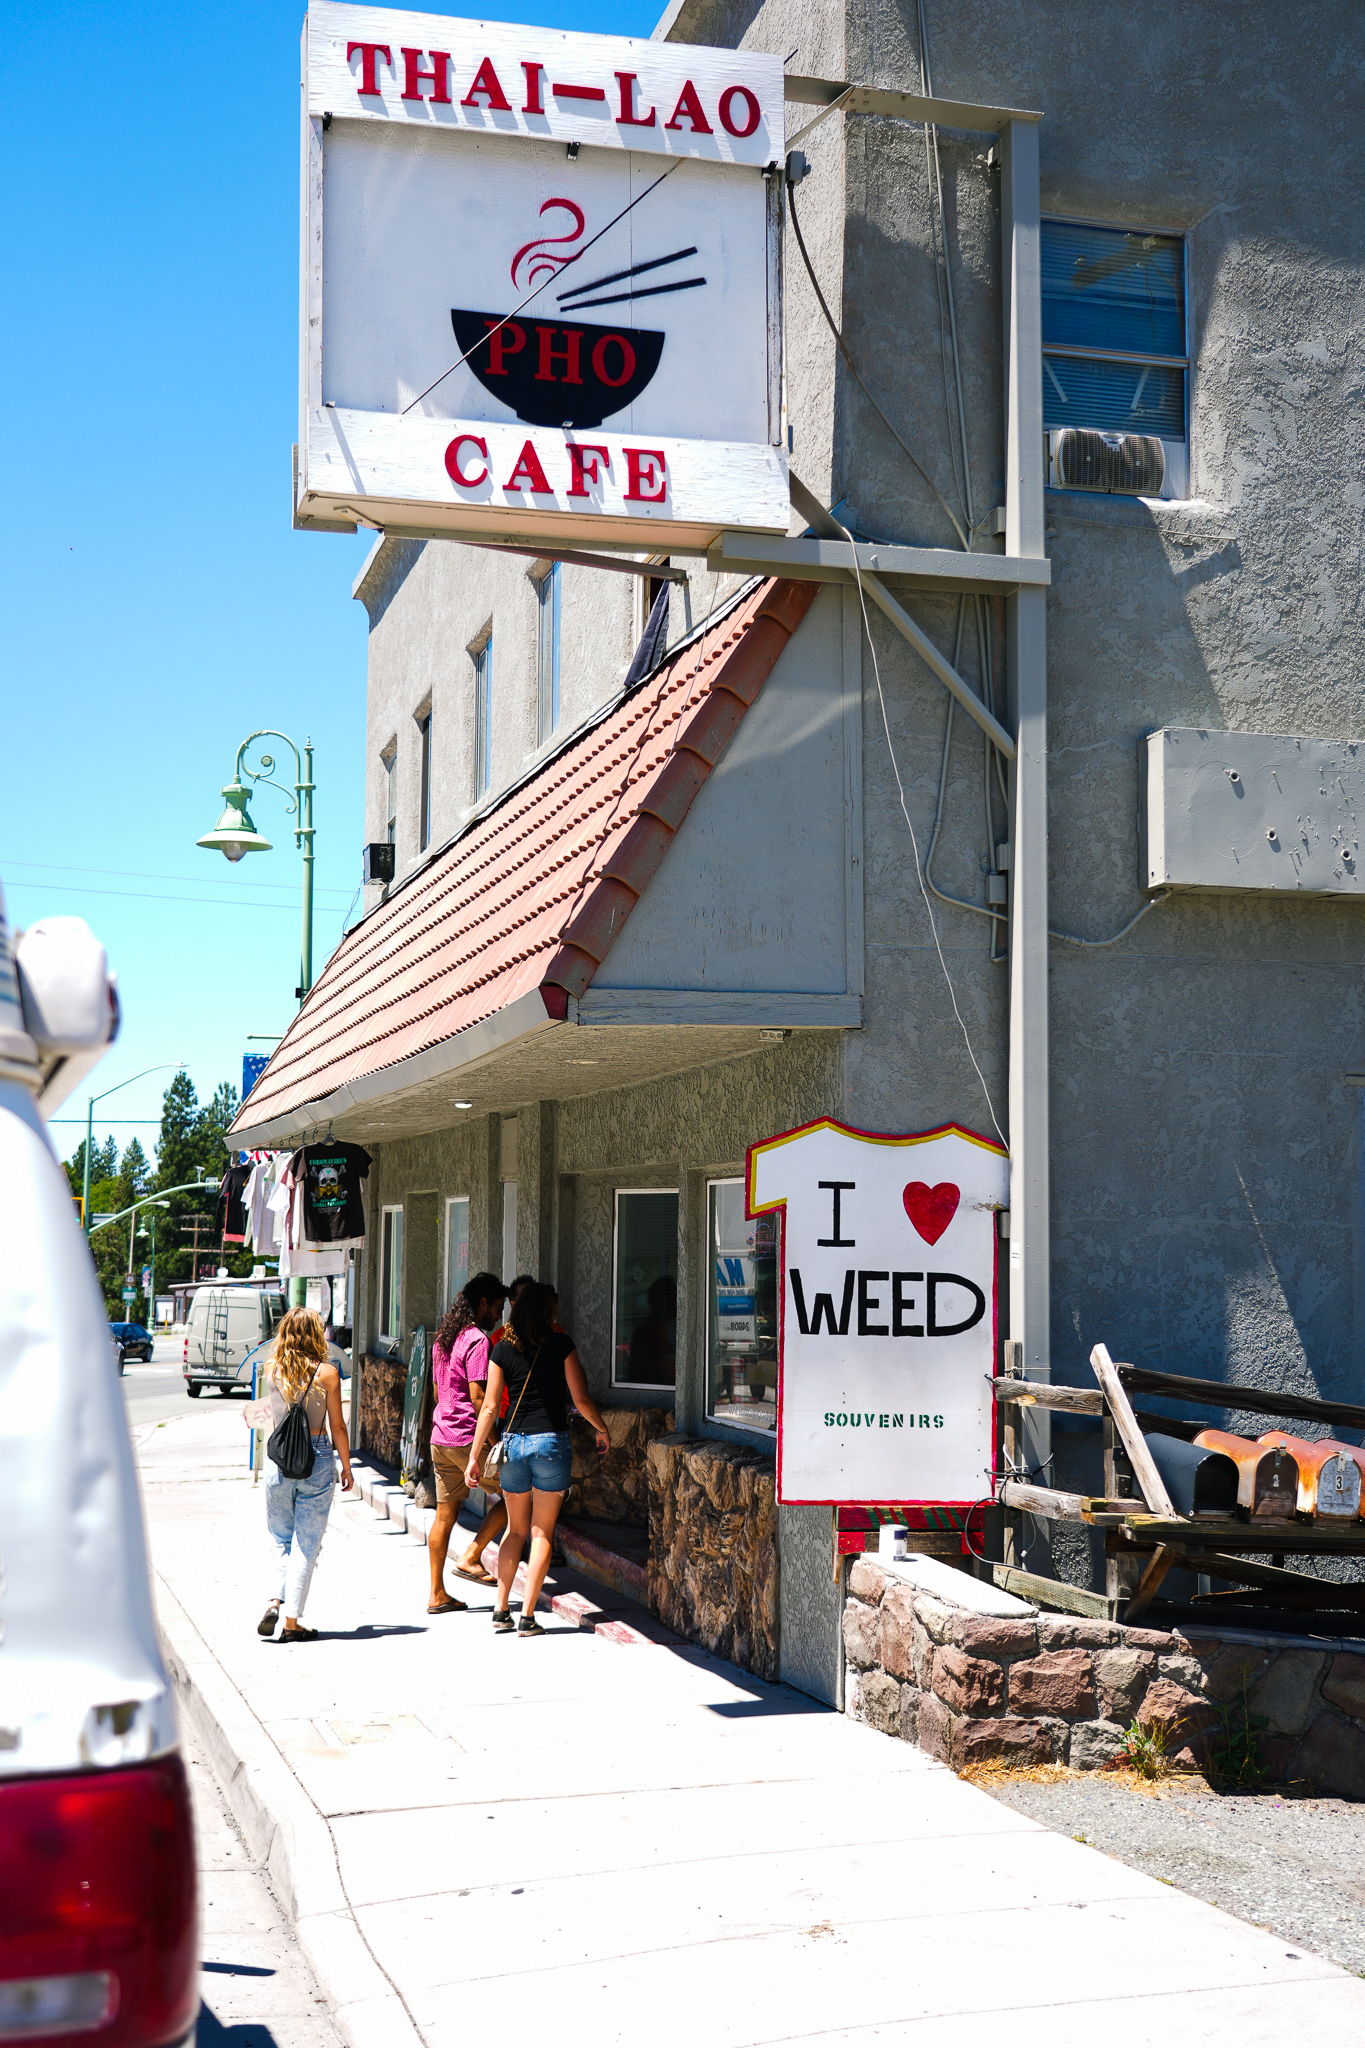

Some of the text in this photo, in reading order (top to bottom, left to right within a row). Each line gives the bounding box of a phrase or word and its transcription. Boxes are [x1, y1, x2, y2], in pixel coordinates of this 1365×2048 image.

[483, 319, 637, 388] PHO
[444, 433, 667, 504] CAFE
[309, 1157, 348, 1166] CORONAVIRUS
[817, 1181, 856, 1247] I
[457, 1242, 469, 1268] OPE
[789, 1268, 986, 1338] WEED
[823, 1411, 945, 1429] SOUVENIRS
[1336, 1475, 1343, 1490] 3
